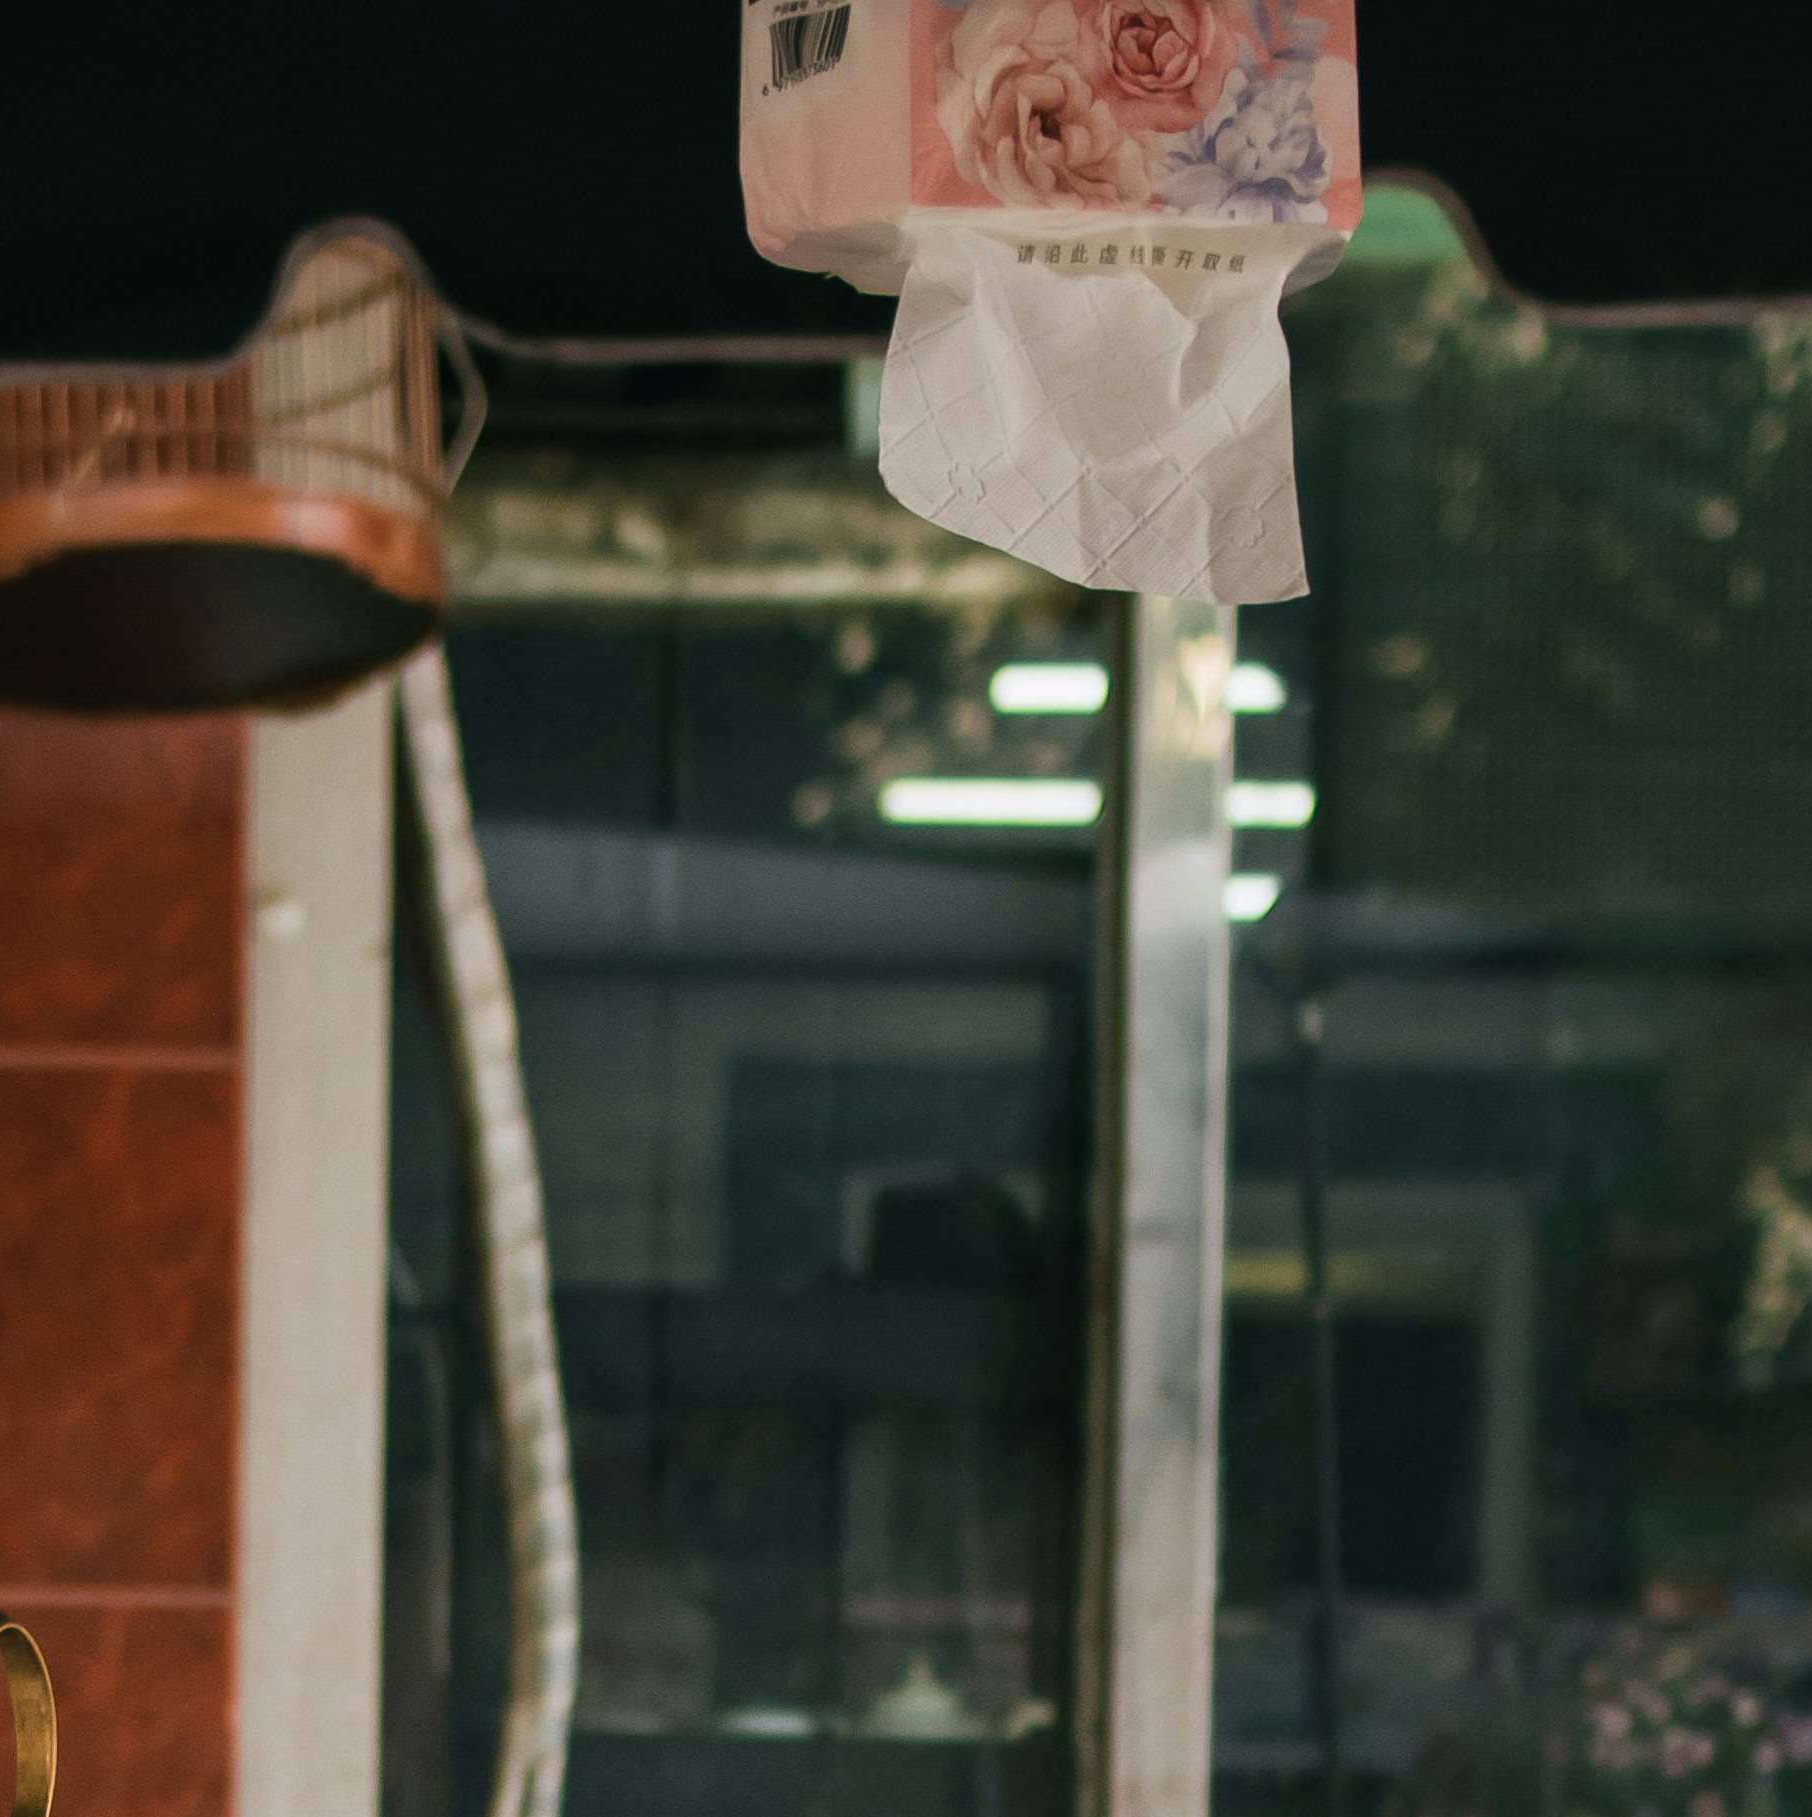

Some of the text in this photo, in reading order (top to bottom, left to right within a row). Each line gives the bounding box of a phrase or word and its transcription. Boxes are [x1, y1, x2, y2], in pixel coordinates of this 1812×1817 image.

[1017, 244, 1245, 273] 请沿此虚线撕开取纸
